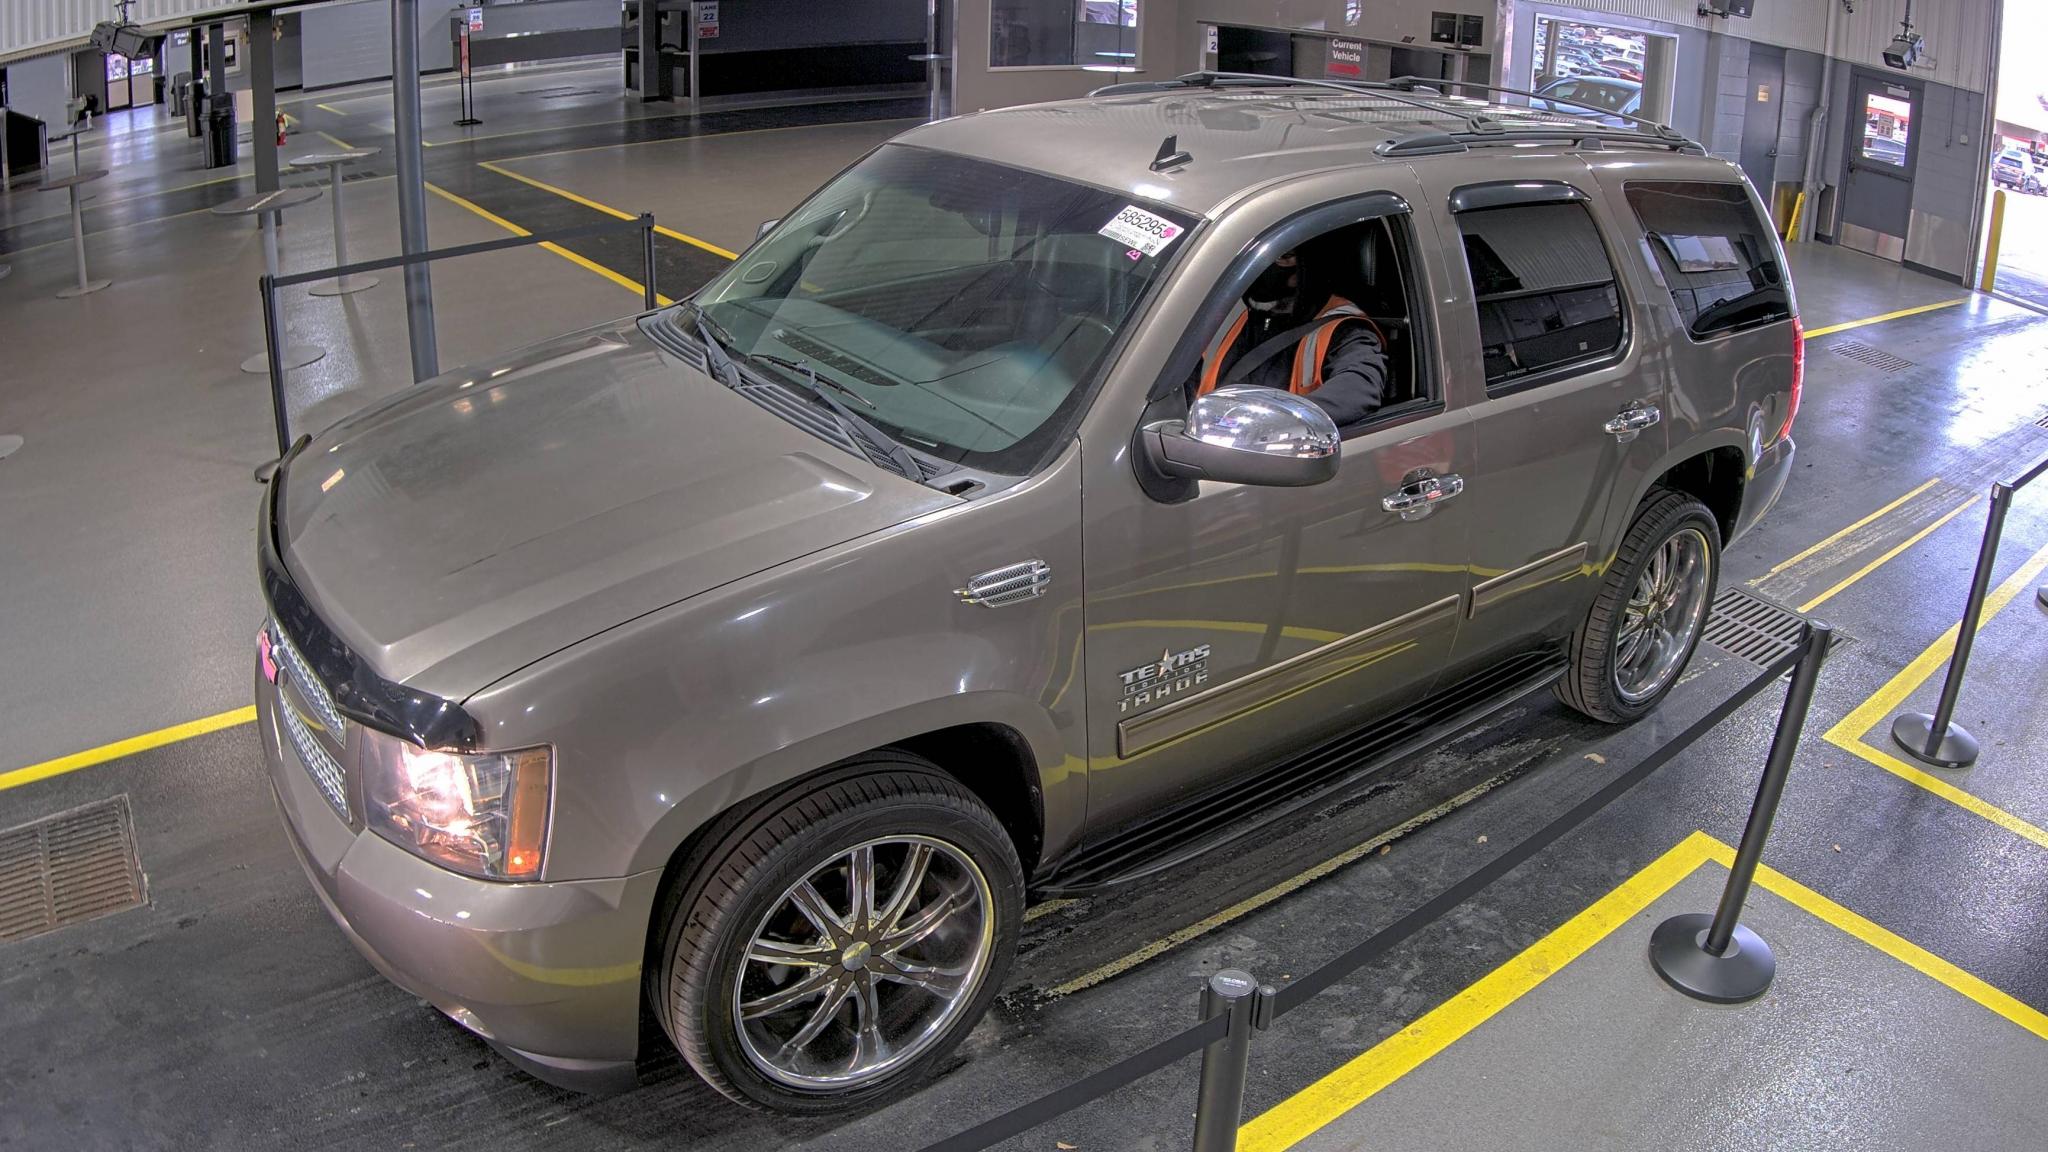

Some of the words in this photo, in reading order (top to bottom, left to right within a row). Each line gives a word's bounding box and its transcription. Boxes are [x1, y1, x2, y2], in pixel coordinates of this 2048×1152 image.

[1332, 39, 1362, 51] Current
[1332, 50, 1361, 62] Vehicle
[1119, 644, 1211, 684] TEXAS
[1129, 662, 1202, 692] EDITION
[1117, 668, 1209, 712] TAHOE
